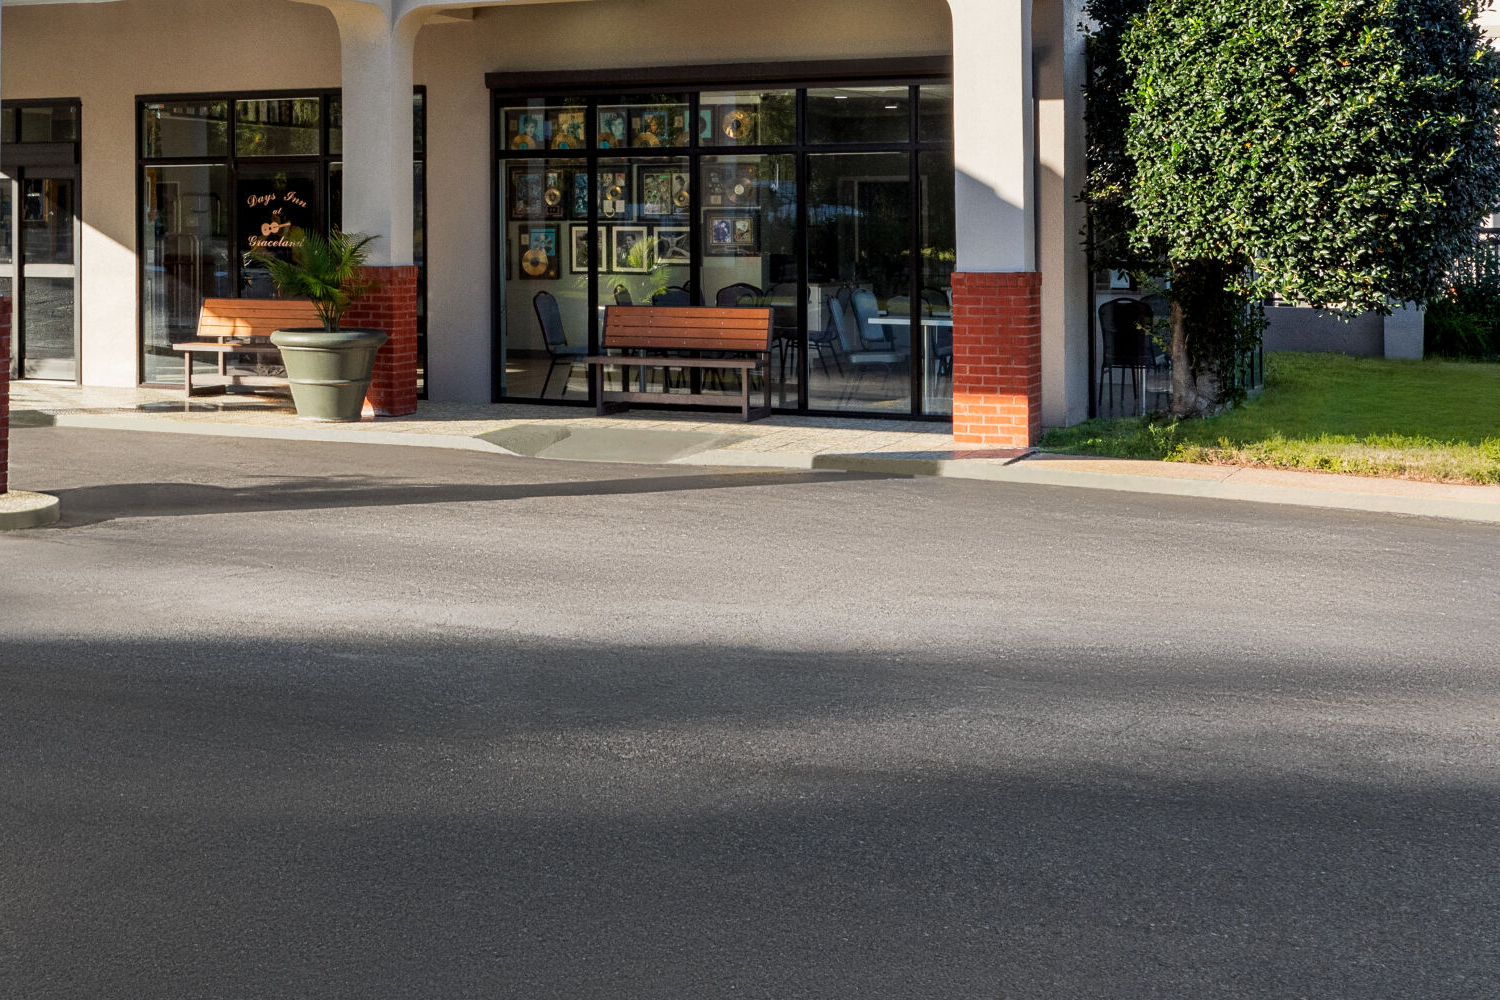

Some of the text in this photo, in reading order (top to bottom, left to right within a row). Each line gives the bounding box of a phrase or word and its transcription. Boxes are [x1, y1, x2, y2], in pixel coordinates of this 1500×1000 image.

[247, 191, 307, 208] Days Inn
[272, 207, 282, 215] at
[248, 235, 305, 247] Graceland
